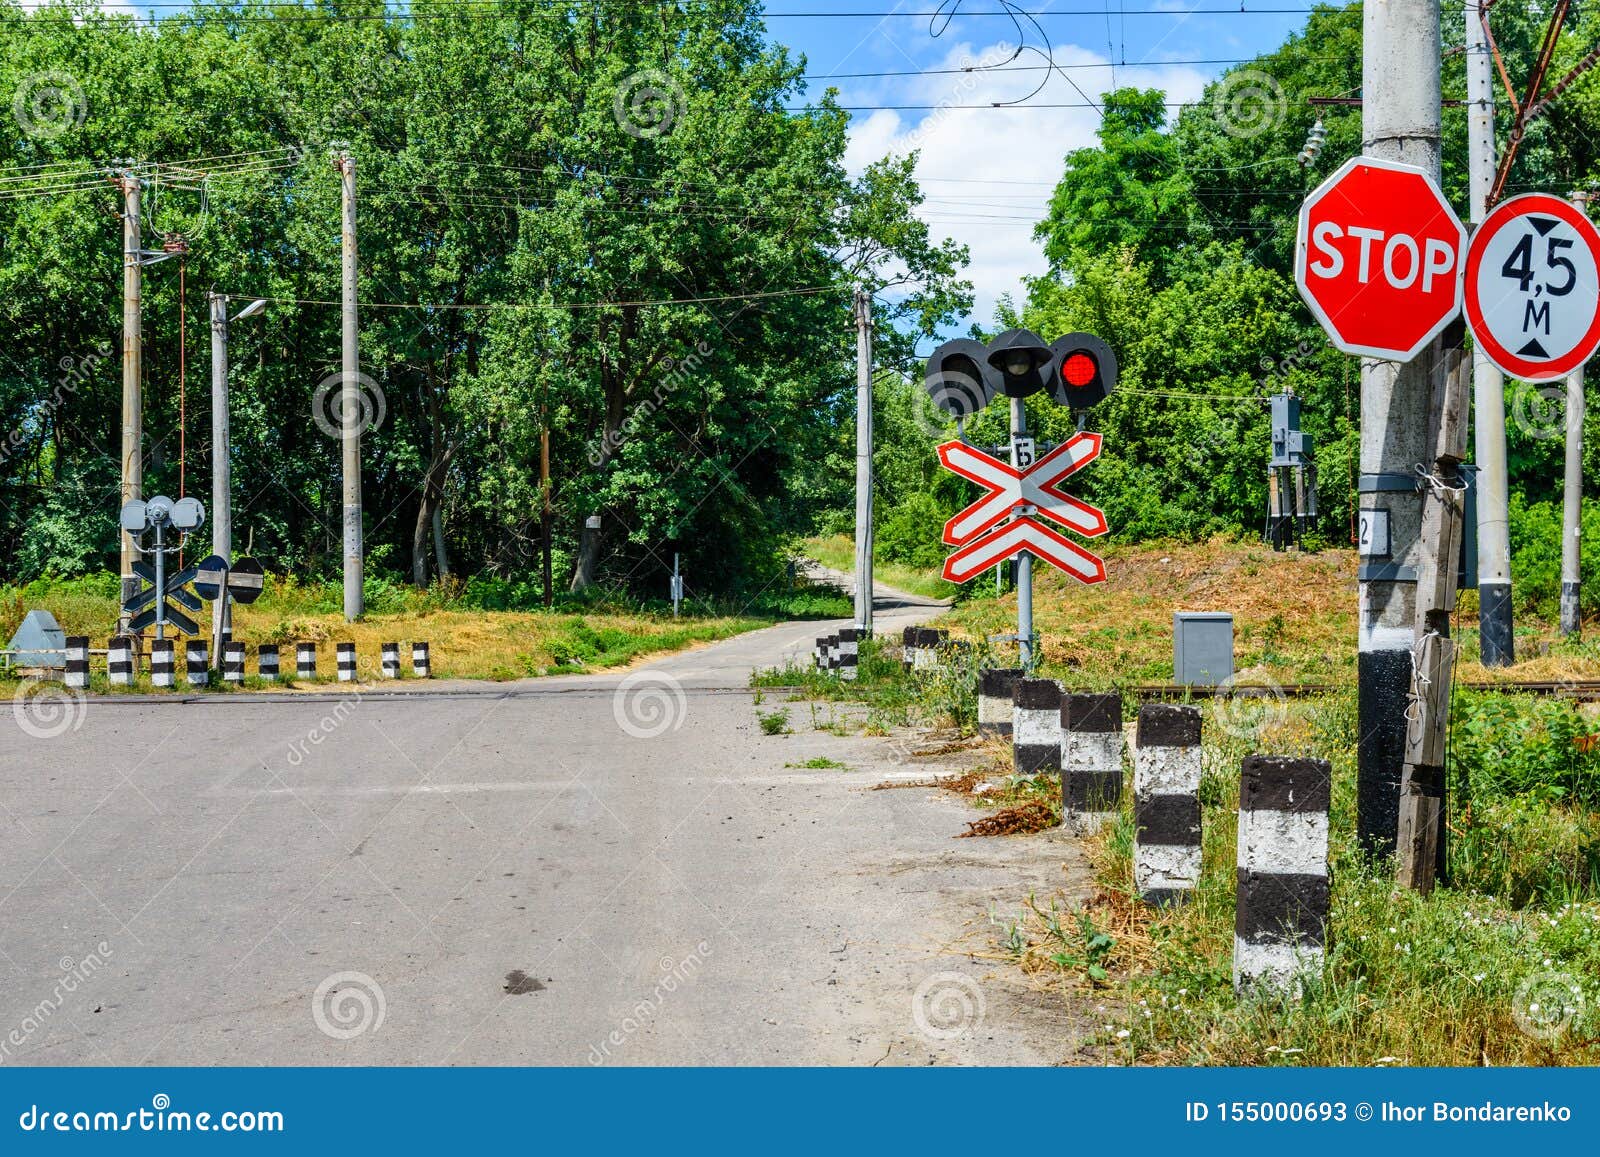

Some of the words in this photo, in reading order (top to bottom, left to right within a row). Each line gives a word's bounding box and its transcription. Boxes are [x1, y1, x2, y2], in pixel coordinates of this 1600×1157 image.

[1310, 221, 1455, 294] STOP
[1502, 233, 1577, 297] 4,5
[1360, 518, 1369, 545] 2
